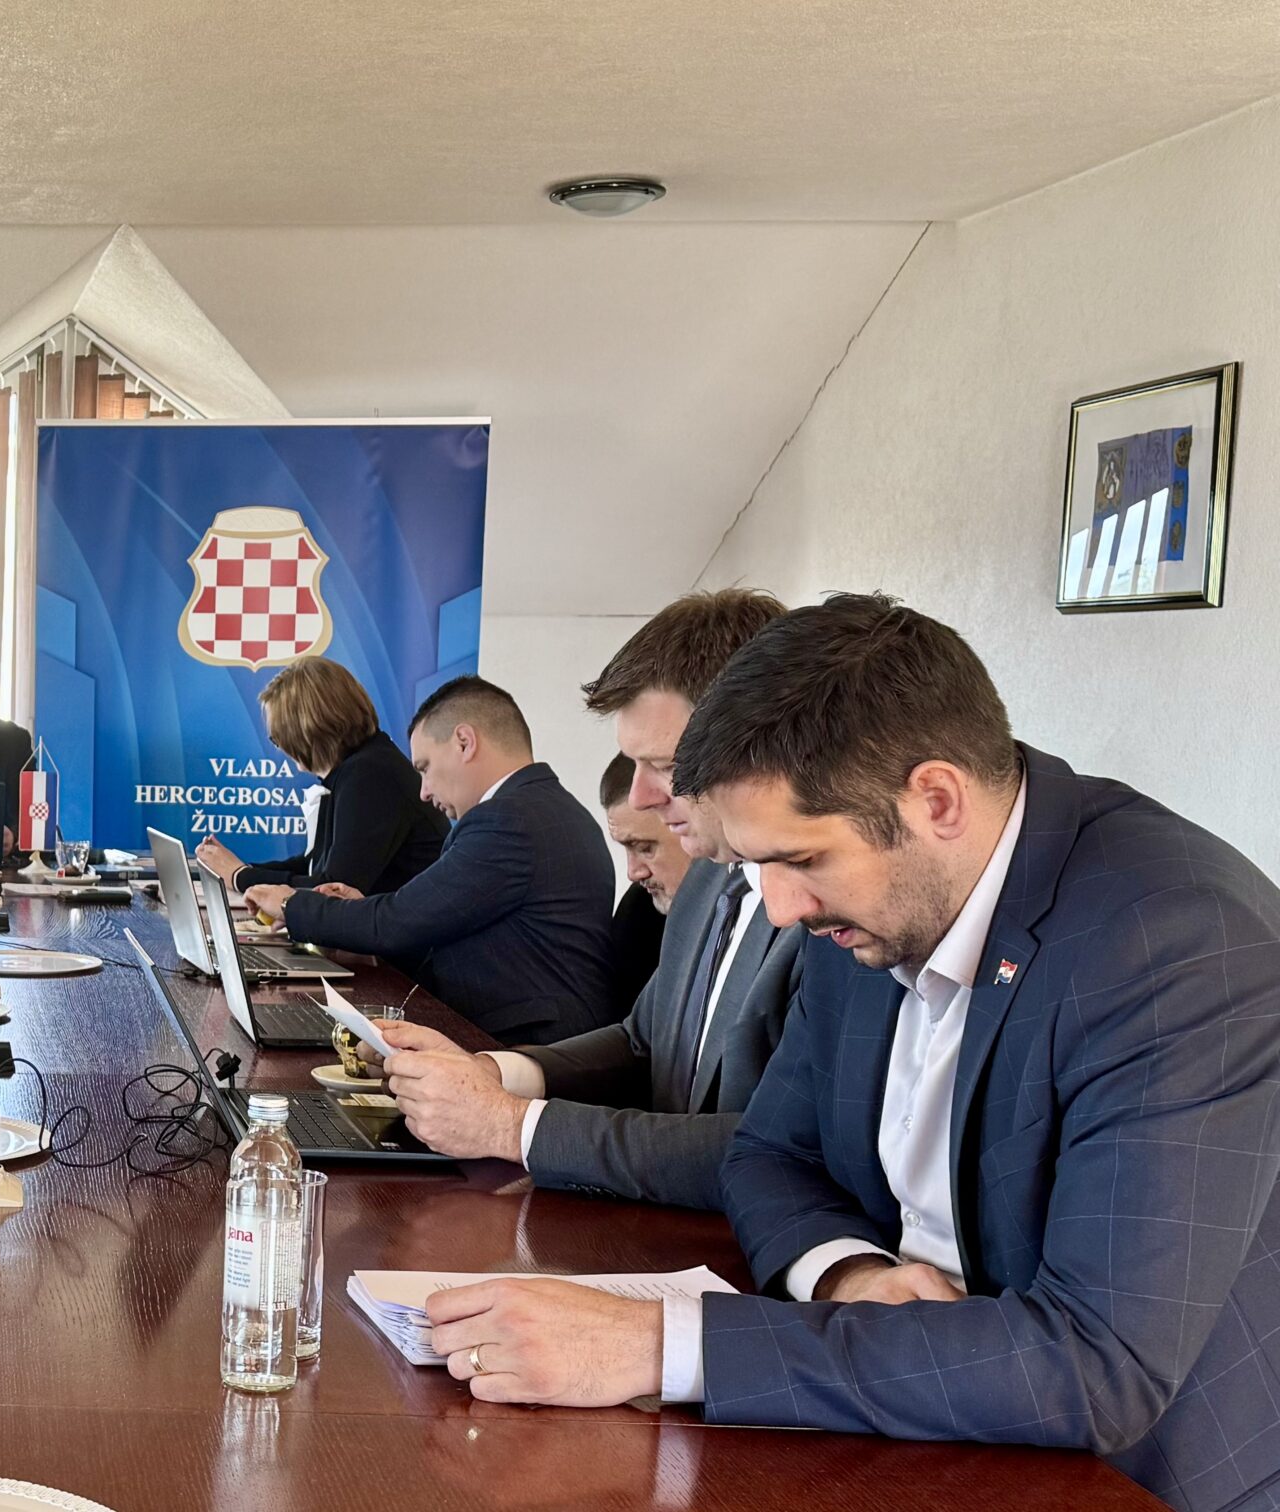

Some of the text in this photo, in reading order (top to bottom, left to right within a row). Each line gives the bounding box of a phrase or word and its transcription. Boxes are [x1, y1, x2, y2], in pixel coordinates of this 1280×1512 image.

[209, 758, 294, 778] VLADA
[135, 785, 307, 807] HERCEGBOSA
[191, 809, 307, 835] ŽUPANIJE
